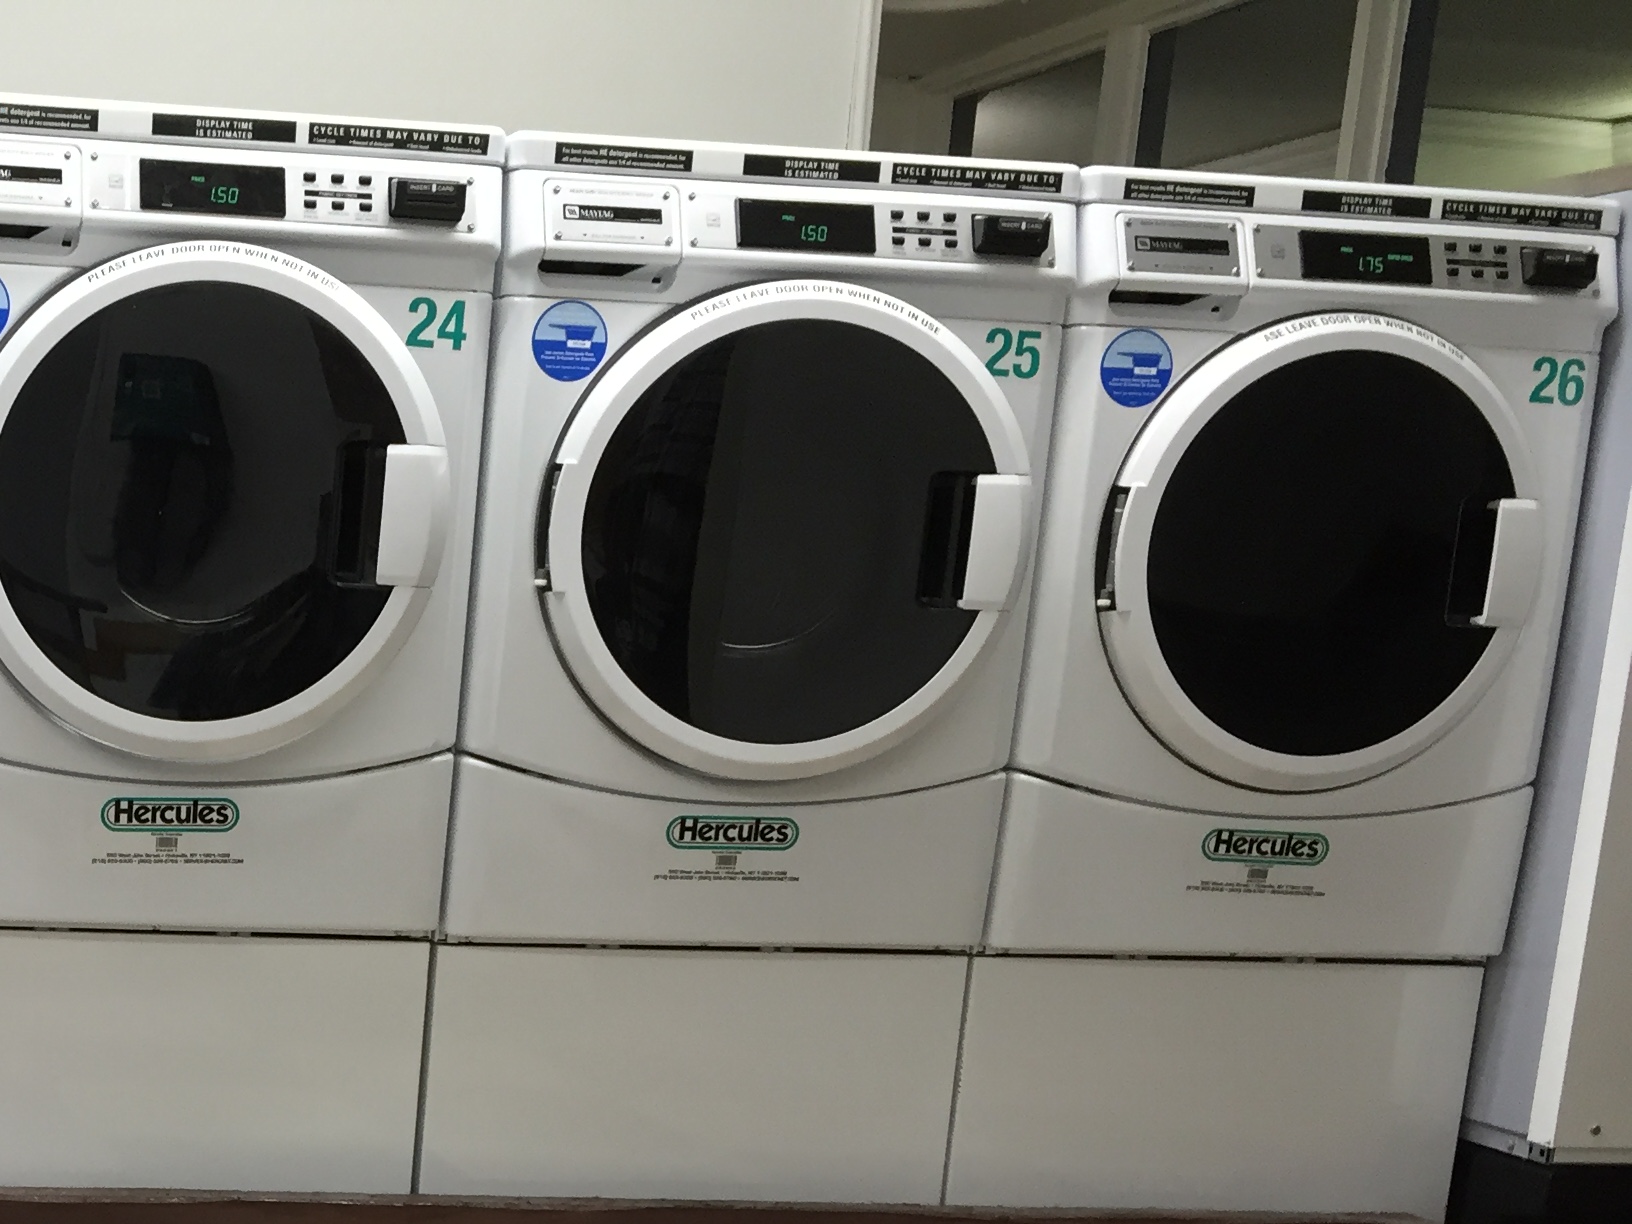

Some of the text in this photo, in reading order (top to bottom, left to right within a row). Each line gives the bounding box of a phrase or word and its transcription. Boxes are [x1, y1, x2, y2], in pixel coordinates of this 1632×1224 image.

[10, 108, 40, 117] detergent
[196, 119, 253, 130] DISPLAY TIME
[207, 130, 252, 139] ESTIMATED
[313, 126, 345, 136] CYCLE
[350, 128, 382, 138] TIMES
[386, 130, 408, 140] MAY
[413, 132, 439, 142] VARY
[444, 134, 462, 144] DUE
[600, 148, 608, 156] HE
[609, 149, 638, 158] detergent
[785, 160, 839, 170] DISPLAY TIME
[896, 166, 926, 176] CYCLE
[932, 168, 961, 178] TIMES
[966, 170, 986, 180] MAY
[991, 172, 1016, 182] VARY
[1020, 174, 1038, 182] DUE
[795, 170, 838, 180] ESTIMATED
[1340, 204, 1392, 215] IS ESTIMATED
[1342, 196, 1392, 206] DISPLAY TIME
[580, 208, 614, 218] MAYTAG
[1446, 202, 1474, 212] CYCLE
[1479, 204, 1507, 214] TIMES
[1512, 206, 1531, 216] MAY
[1535, 208, 1558, 218] VARY
[1562, 210, 1578, 220] DUE
[88, 244, 340, 291] PLEASE LEAVE DOOR OPEN WHEN NOT IN USE
[691, 284, 940, 335] PLEASE LEAVE DOOR OPEN WHEN NOT IN USE
[406, 297, 466, 350] 24
[1287, 319, 1320, 334] LEAVE
[1321, 315, 1350, 325] DOOR
[1354, 315, 1382, 326] OPEN
[1384, 319, 1414, 334] WHEN
[1416, 328, 1435, 343] NOT
[1437, 338, 1446, 349] IN
[1448, 346, 1465, 361] USE
[986, 327, 1042, 379] 25
[1529, 356, 1586, 406] 26
[114, 798, 229, 825] Hercules
[679, 818, 788, 843] Hercules
[1214, 830, 1319, 858] Hercules
